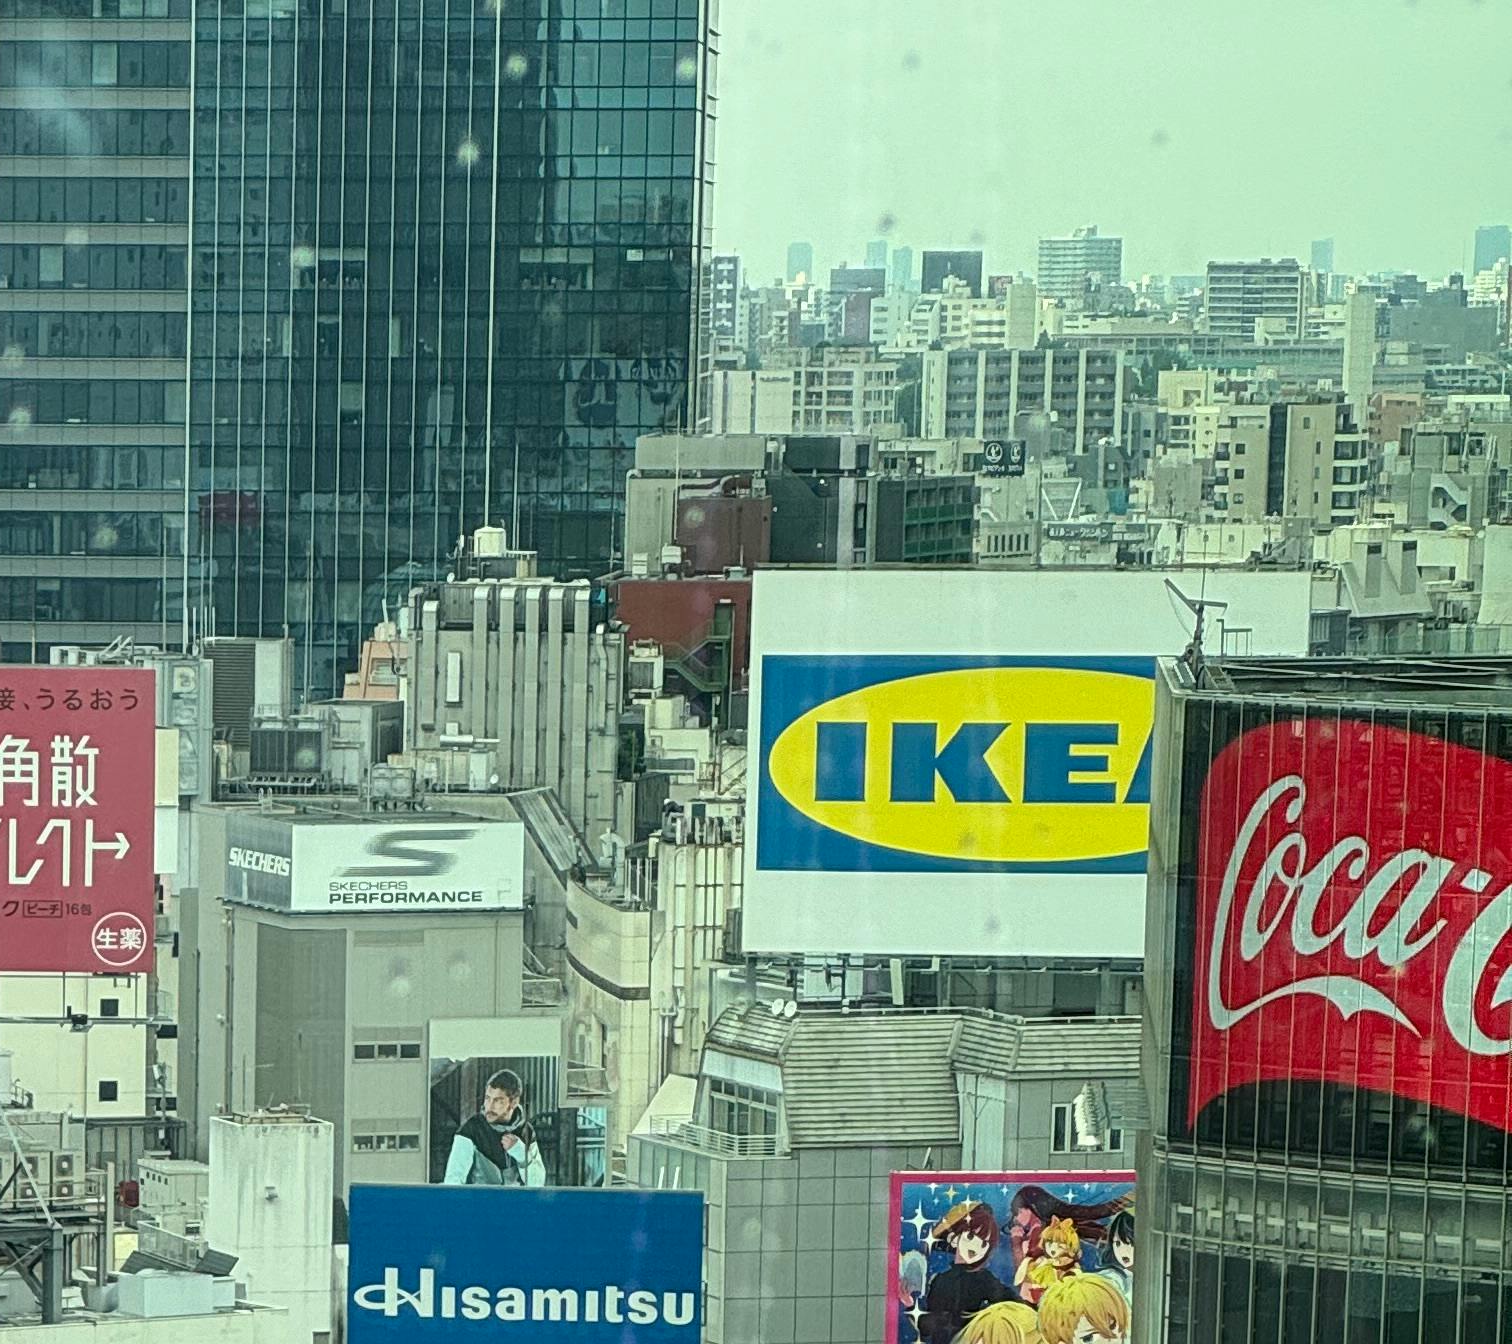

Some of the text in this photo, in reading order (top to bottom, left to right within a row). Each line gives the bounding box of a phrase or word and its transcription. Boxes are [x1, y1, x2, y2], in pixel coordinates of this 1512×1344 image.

[228, 846, 290, 877] SKECHERS
[329, 881, 408, 892] SKECHERS
[329, 890, 482, 905] PERFORMANCE
[96, 926, 143, 949] 生薬
[353, 1267, 695, 1325] Hisamitsu
